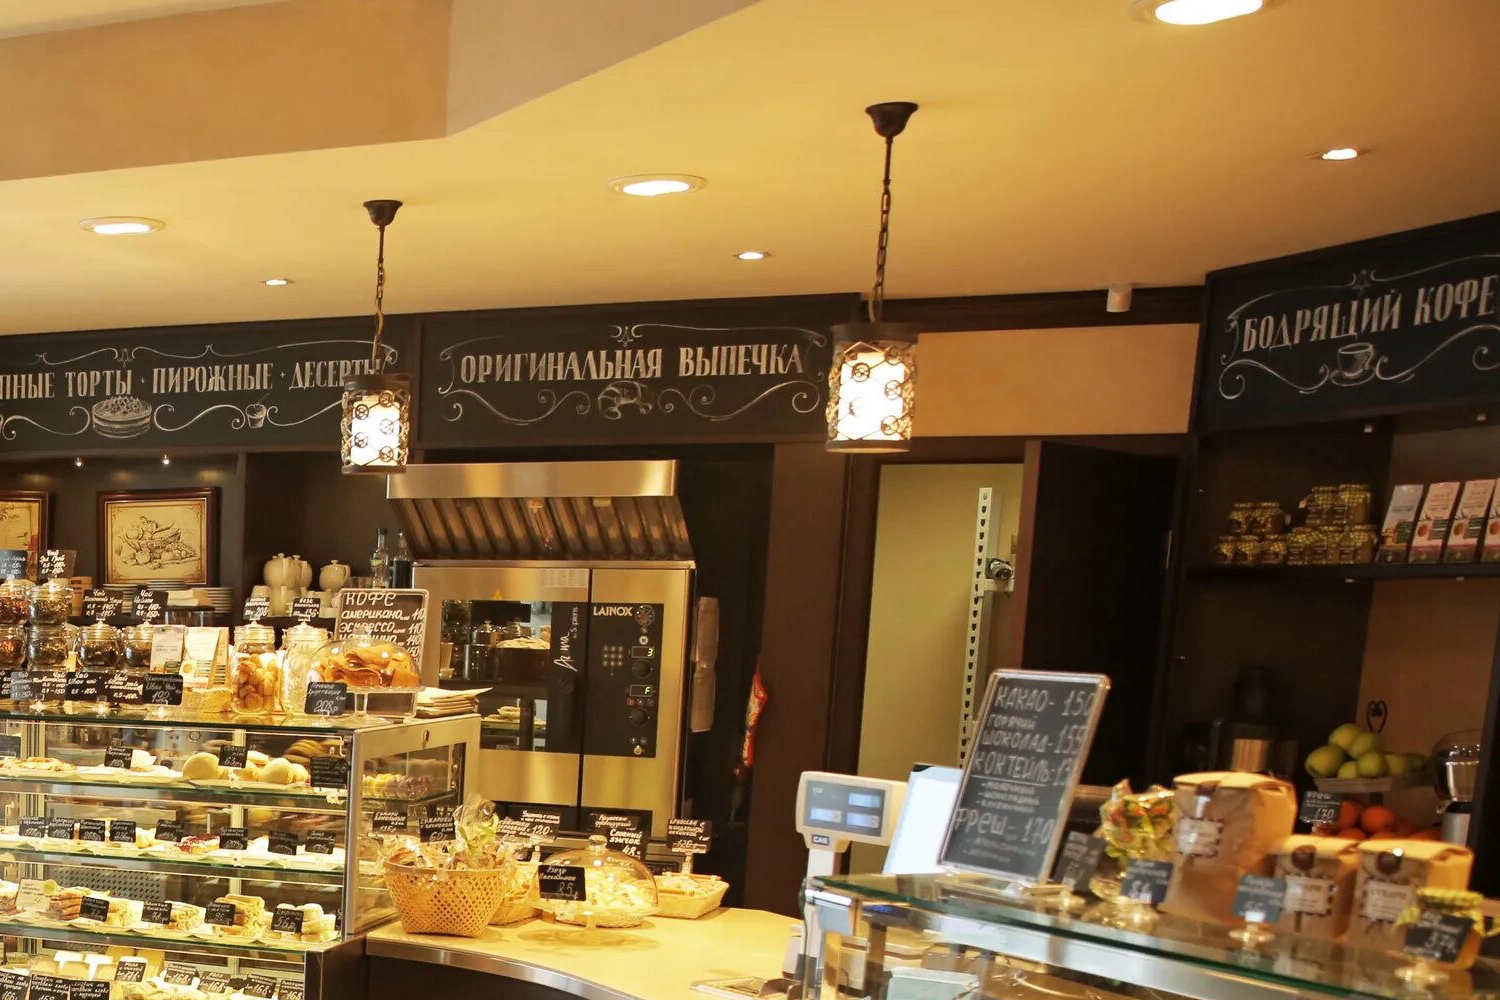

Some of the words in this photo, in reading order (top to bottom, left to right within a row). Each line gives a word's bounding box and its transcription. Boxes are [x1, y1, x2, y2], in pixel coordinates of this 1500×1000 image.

[1242, 289, 1403, 352] БОДРЯЩИЙ
[1413, 273, 1498, 327] КОФЕ
[65, 367, 132, 399] ТОРТЫ
[153, 361, 274, 395] ПИРОЖНЫЕ
[460, 345, 663, 385] ОРИГИНАЛЬНАЯ
[678, 342, 804, 379] ВЫПЕЧКА
[593, 606, 634, 617] LAINOX
